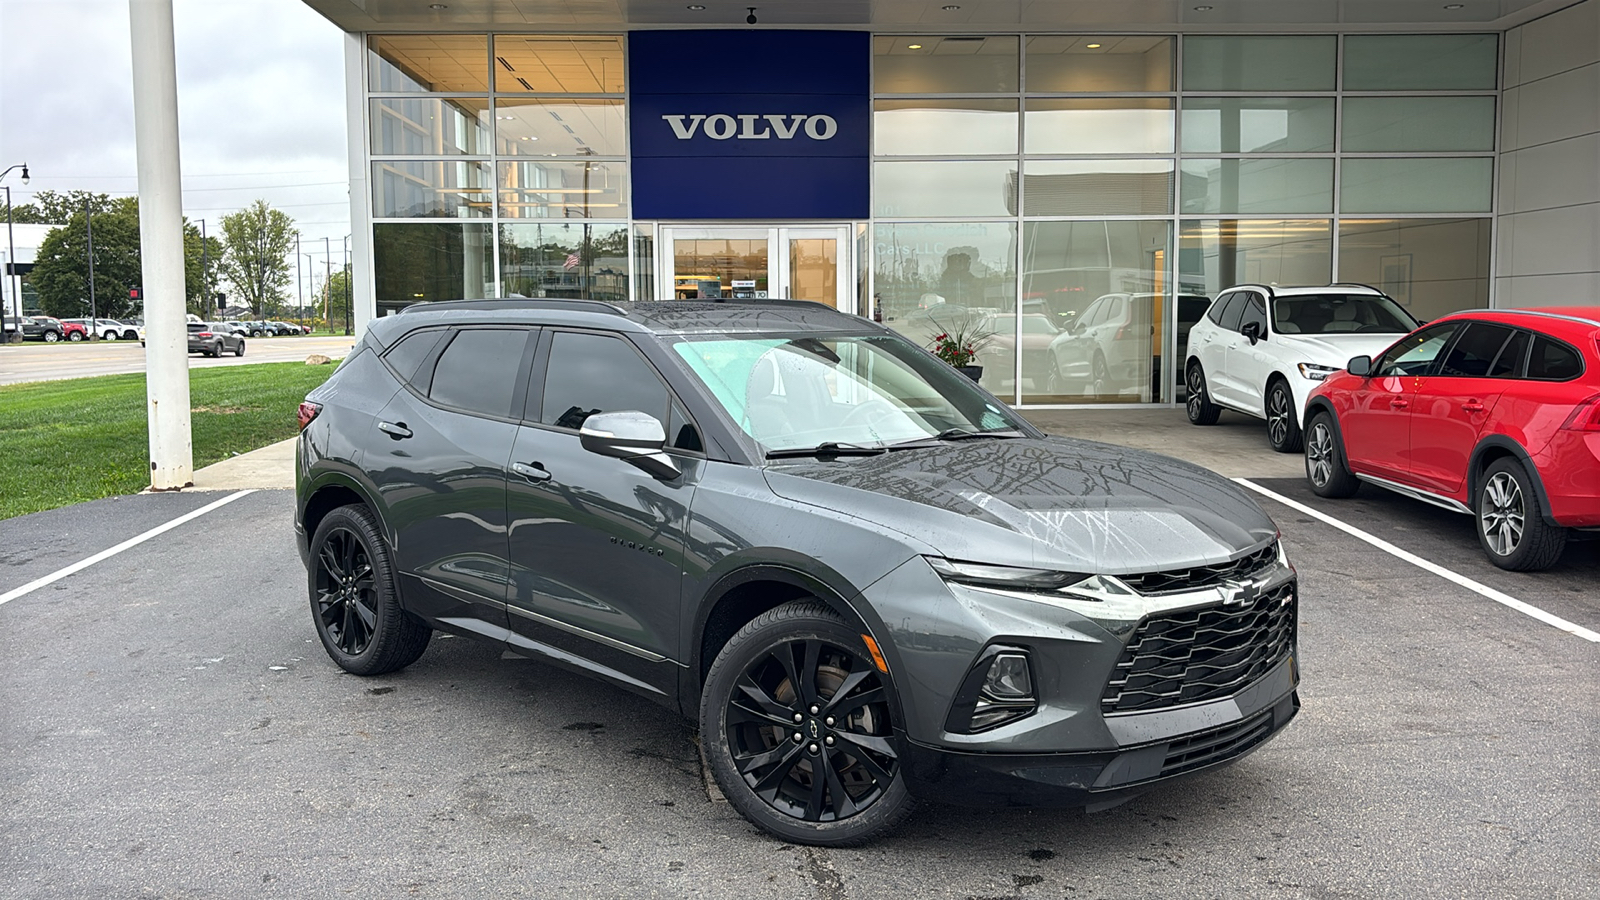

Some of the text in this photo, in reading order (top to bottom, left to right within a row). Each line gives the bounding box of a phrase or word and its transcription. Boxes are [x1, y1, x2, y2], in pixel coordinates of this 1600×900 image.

[662, 114, 838, 140] VOLVO
[876, 242, 944, 255] Cars LLC
[610, 536, 664, 557] BLAZER
